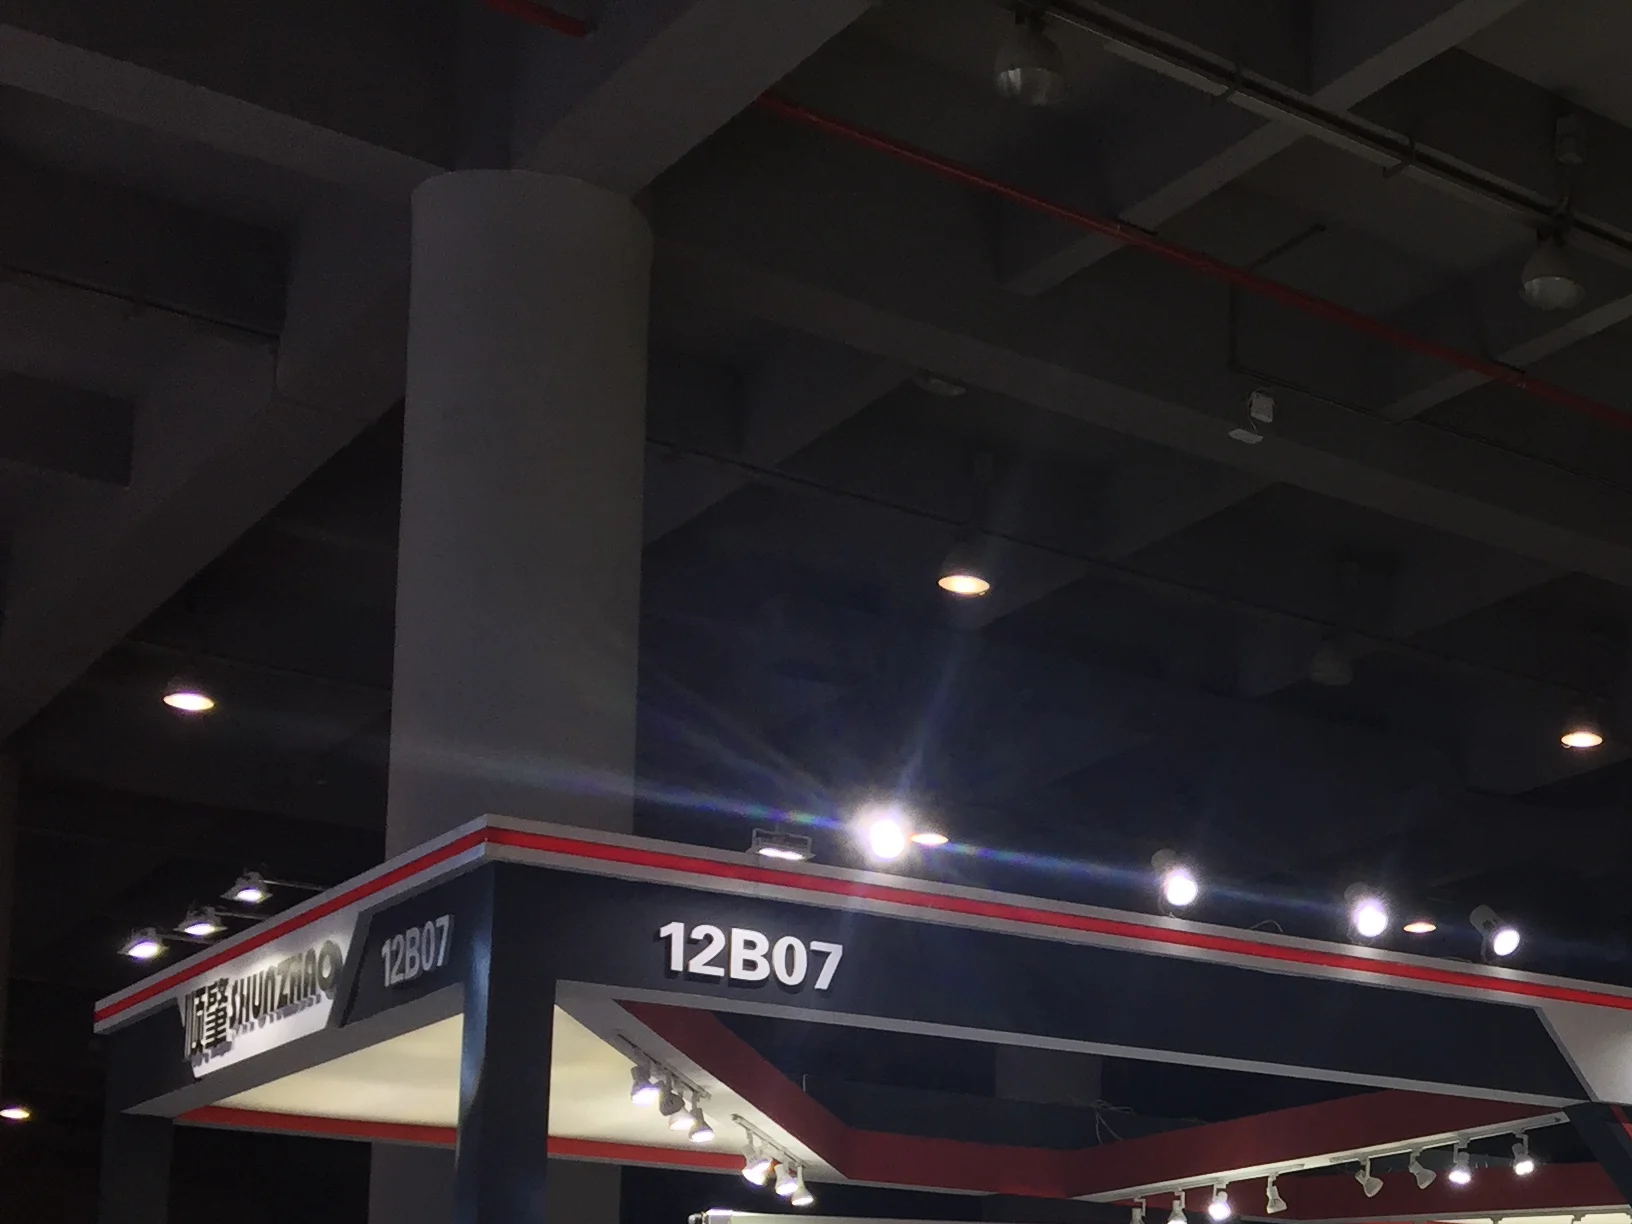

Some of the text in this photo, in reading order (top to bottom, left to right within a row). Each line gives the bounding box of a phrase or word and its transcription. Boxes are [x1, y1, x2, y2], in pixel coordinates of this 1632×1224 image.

[382, 915, 452, 986] 12B07
[659, 922, 843, 991] 12B07
[184, 940, 345, 1056] 顺肇 SHUNZHAO
